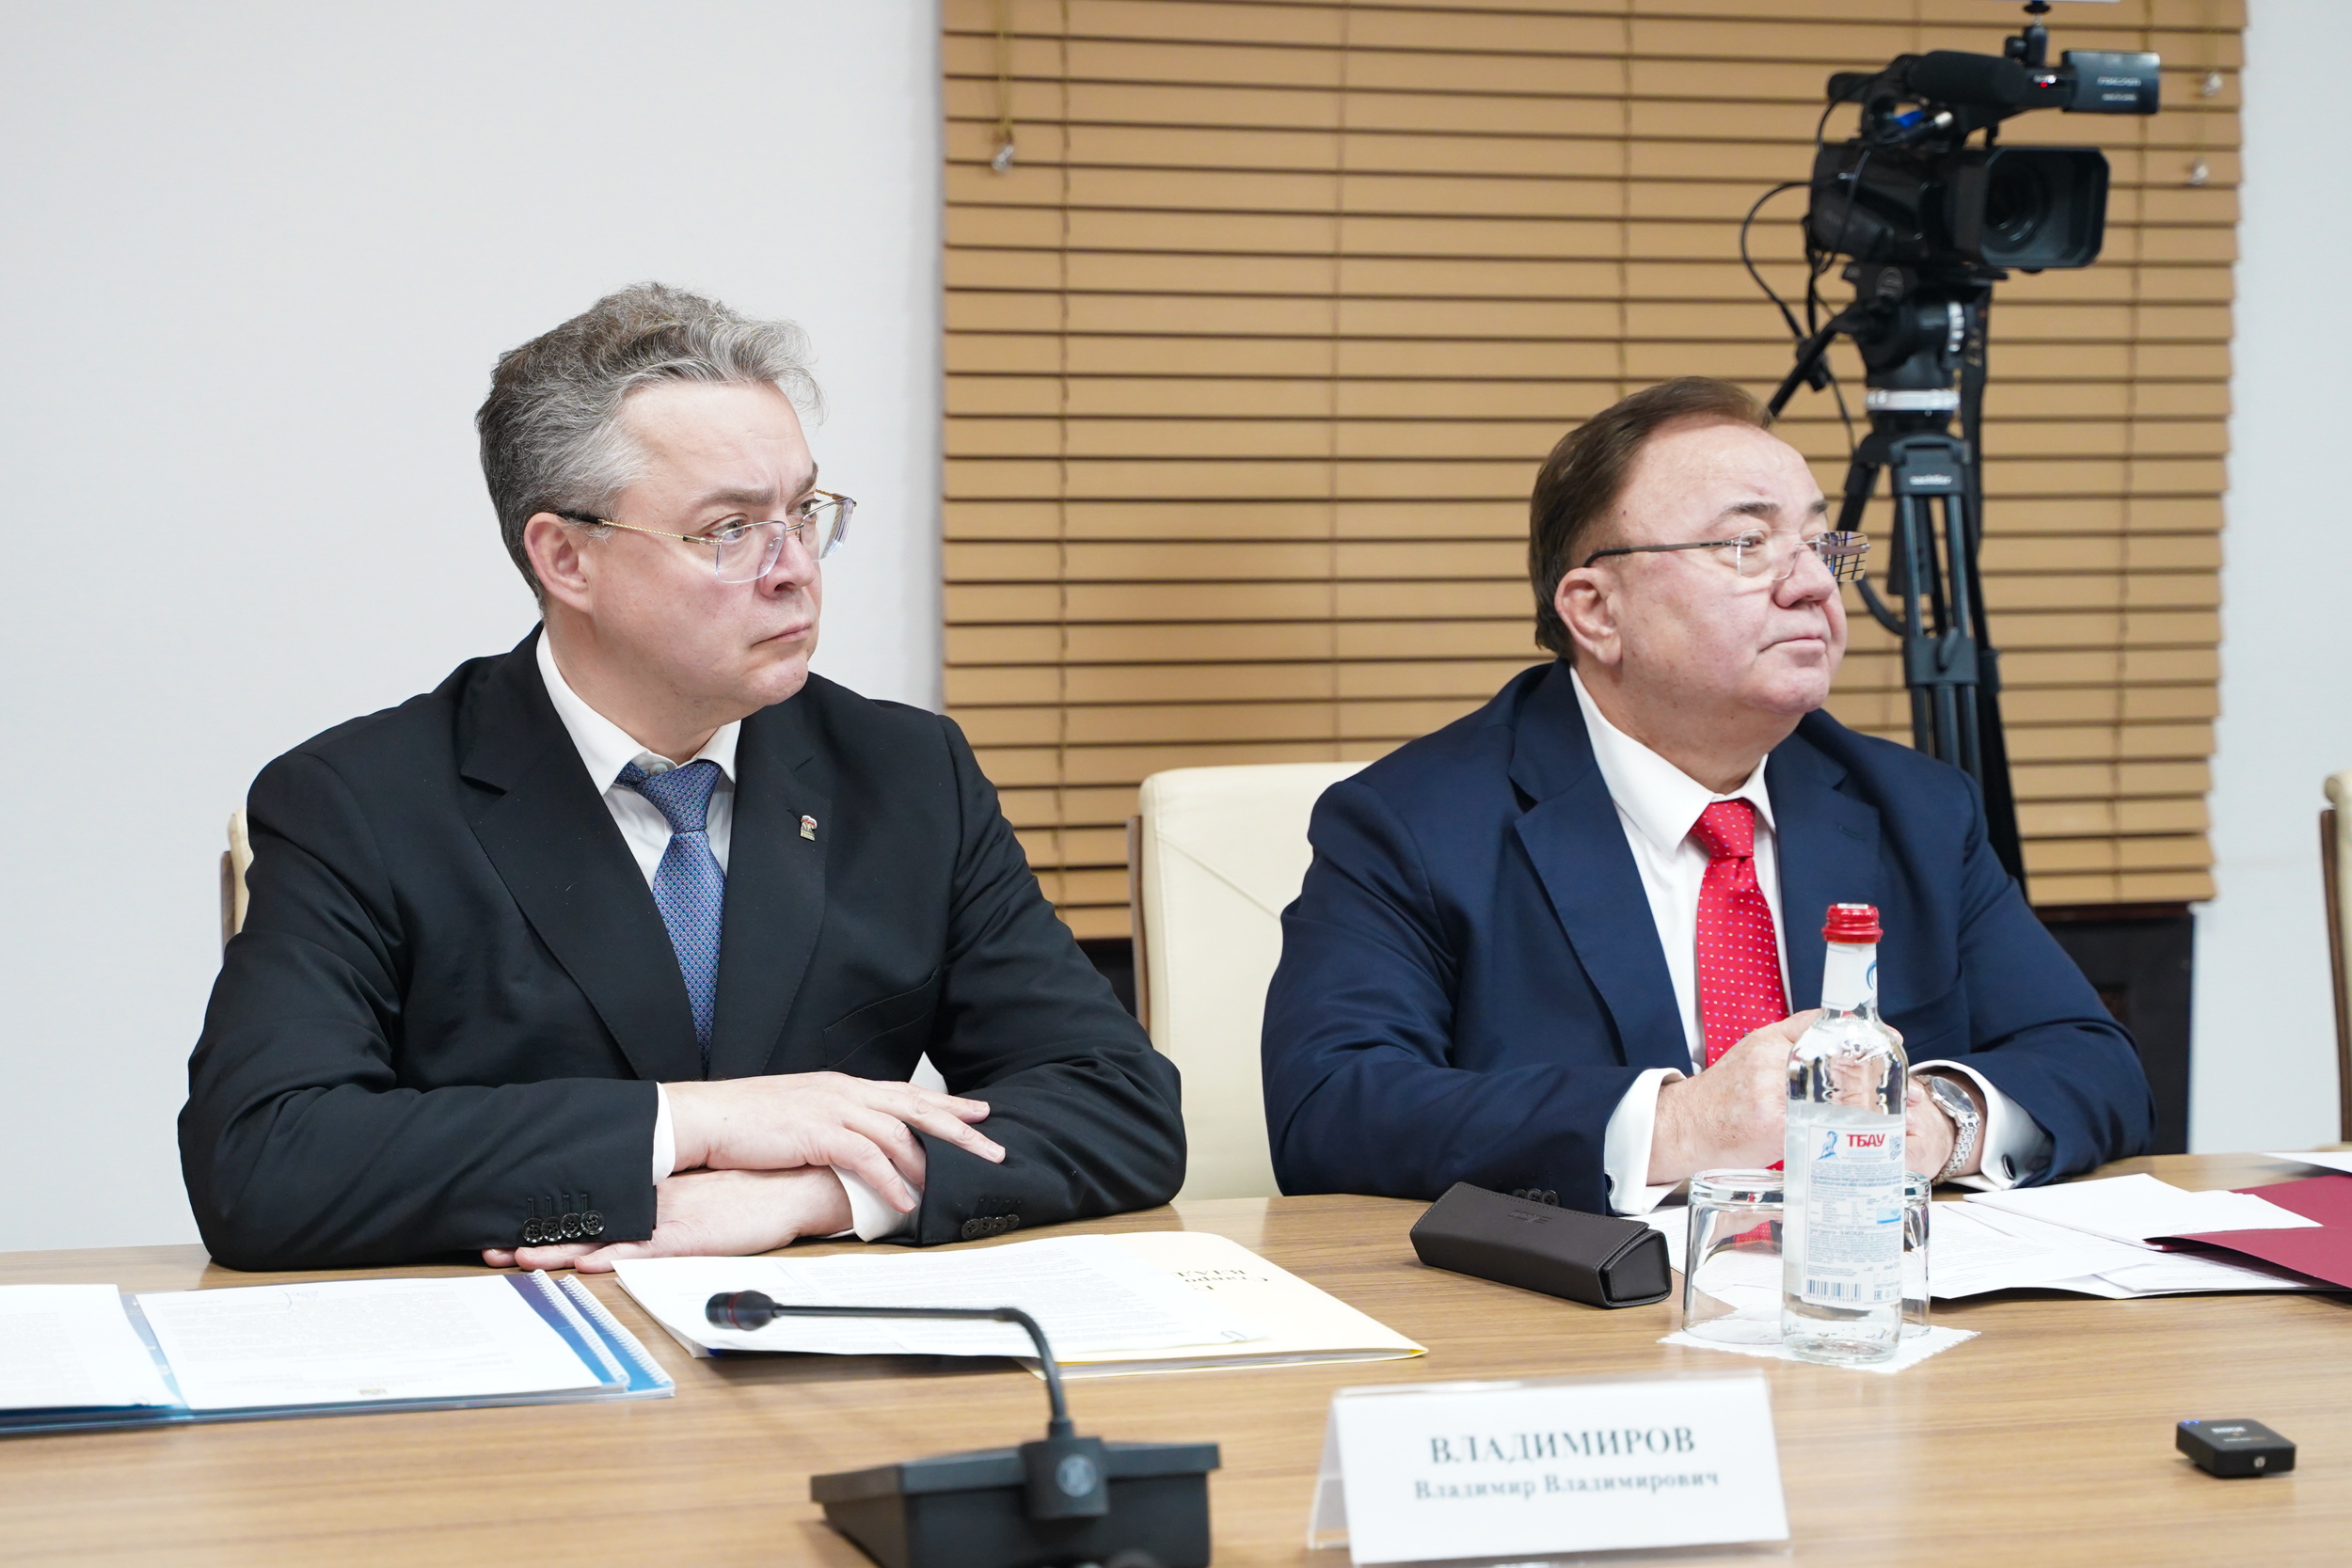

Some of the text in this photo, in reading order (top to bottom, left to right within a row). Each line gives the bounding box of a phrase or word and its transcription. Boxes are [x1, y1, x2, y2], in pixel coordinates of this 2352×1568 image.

[1846, 1133, 1885, 1148] ТБАУ
[1430, 1426, 1697, 1466] ВЛАДИМИРОВ
[1414, 1470, 1720, 1501] Владимир Владимирович
